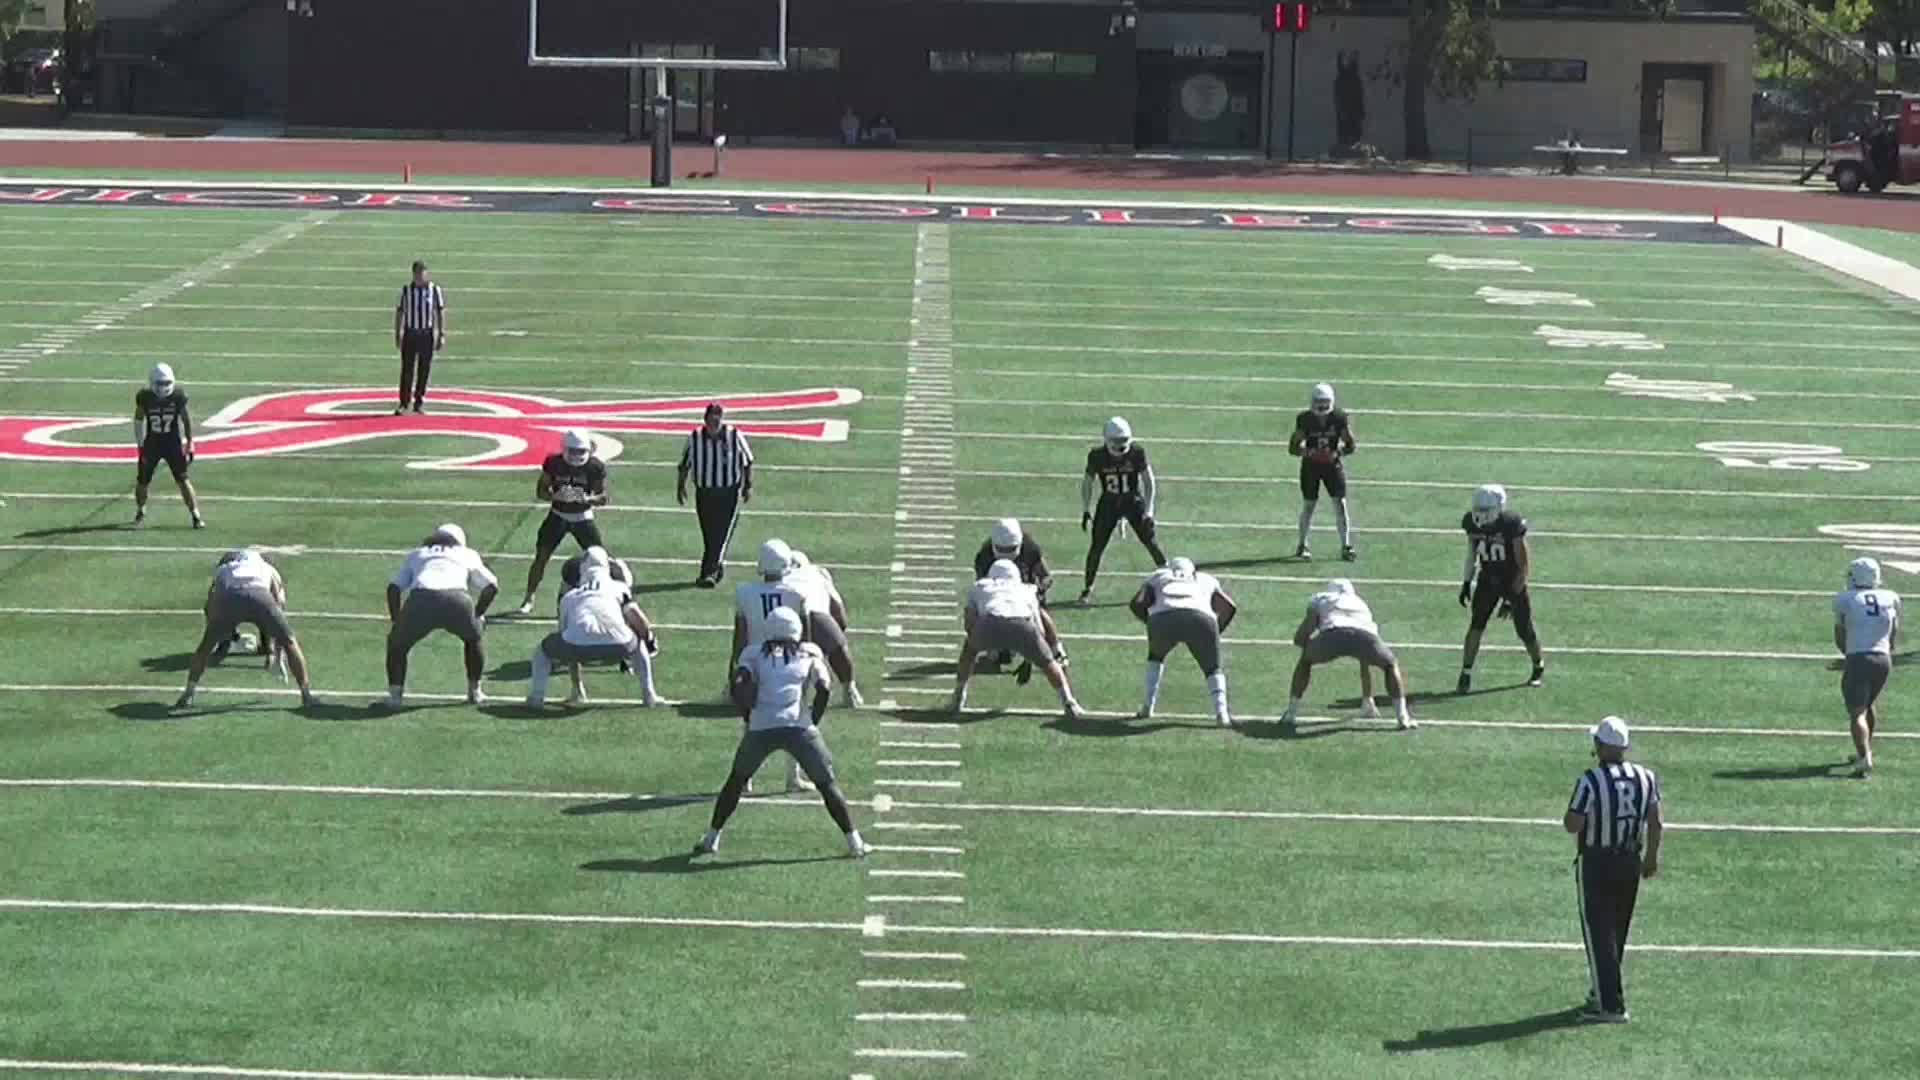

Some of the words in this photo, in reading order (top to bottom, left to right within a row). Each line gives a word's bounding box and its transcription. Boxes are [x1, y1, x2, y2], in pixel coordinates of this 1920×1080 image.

[593, 198, 1657, 238] COLLEGE
[148, 415, 174, 433] 27
[1695, 440, 1873, 473] 50
[1105, 474, 1131, 493] 21
[1864, 594, 1880, 617] 9
[1614, 780, 1638, 818] R
